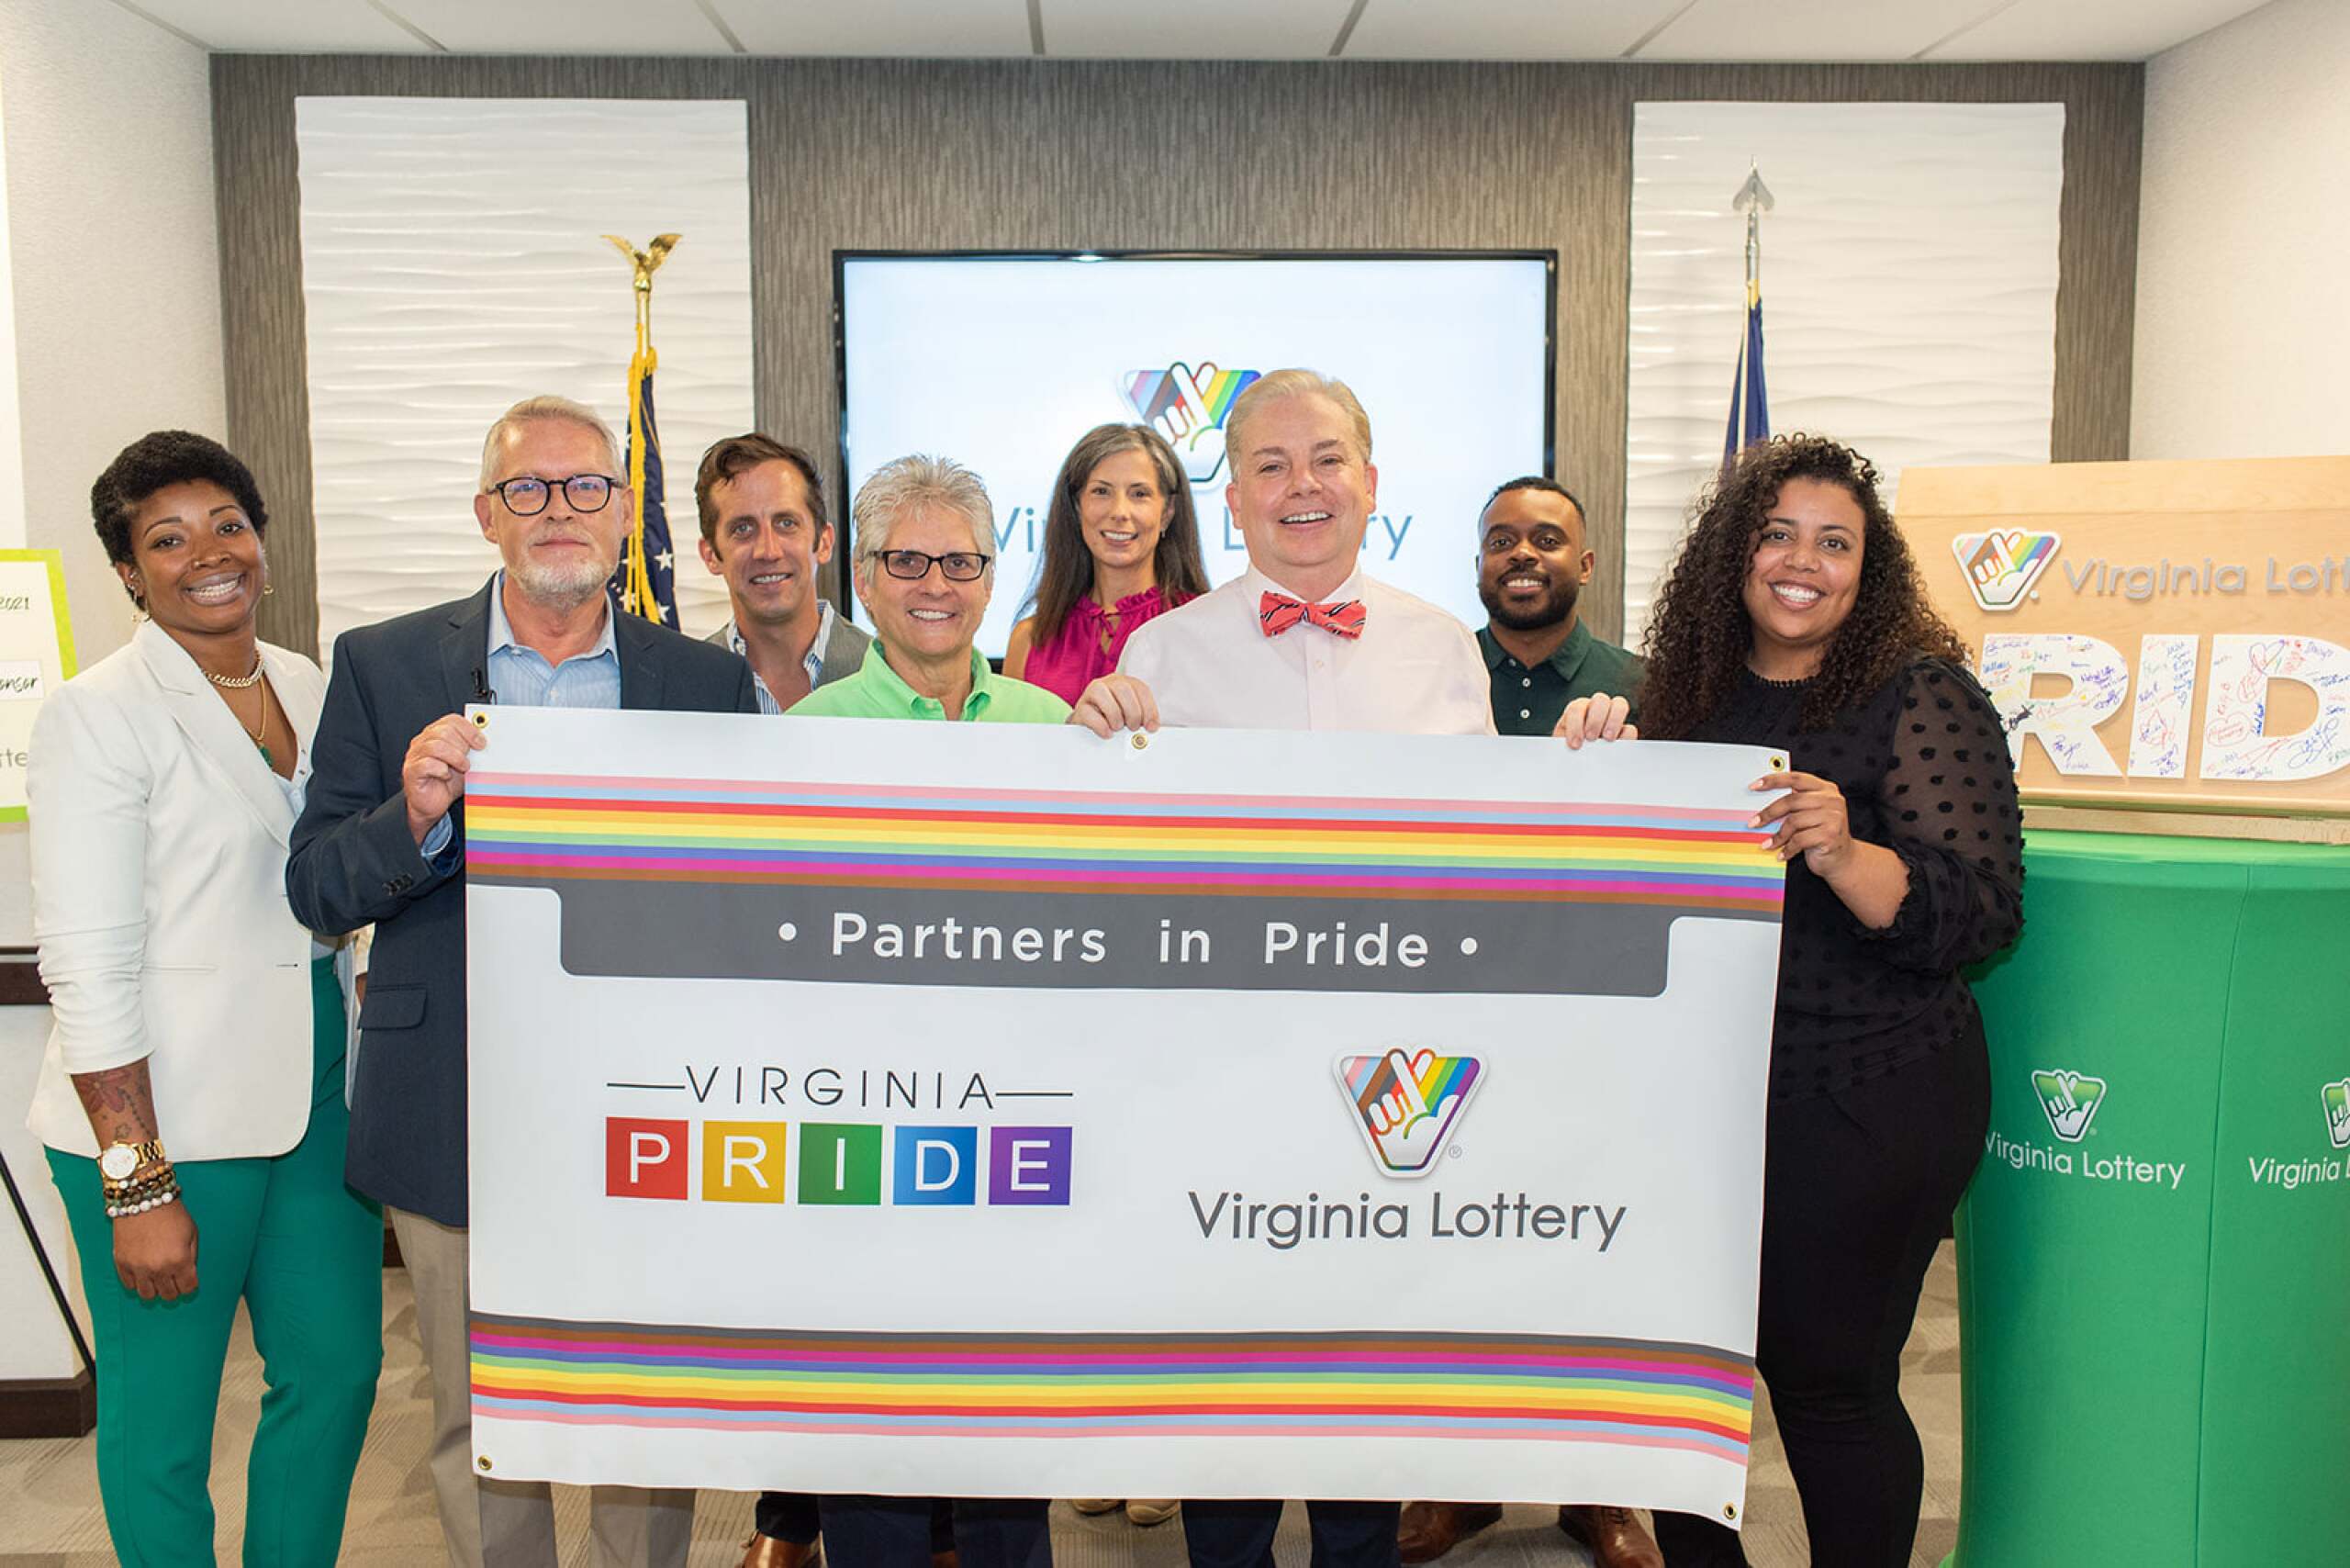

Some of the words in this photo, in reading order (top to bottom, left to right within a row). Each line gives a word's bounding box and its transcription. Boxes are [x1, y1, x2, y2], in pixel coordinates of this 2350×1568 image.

[2063, 557, 2247, 599] Virginia
[1978, 633, 2350, 779] RID
[833, 913, 1107, 963] Partners
[1158, 919, 1211, 963] in
[1264, 923, 1428, 968] Pride
[685, 1066, 993, 1109] VIRGINIA
[628, 1132, 1051, 1192] PRIDE
[1986, 1131, 2072, 1174] Virginia
[2083, 1151, 2186, 1190] Lottery
[2248, 1156, 2341, 1190] Virginia
[1188, 1191, 1409, 1251] Virginia
[1431, 1193, 1627, 1252] Lottery
